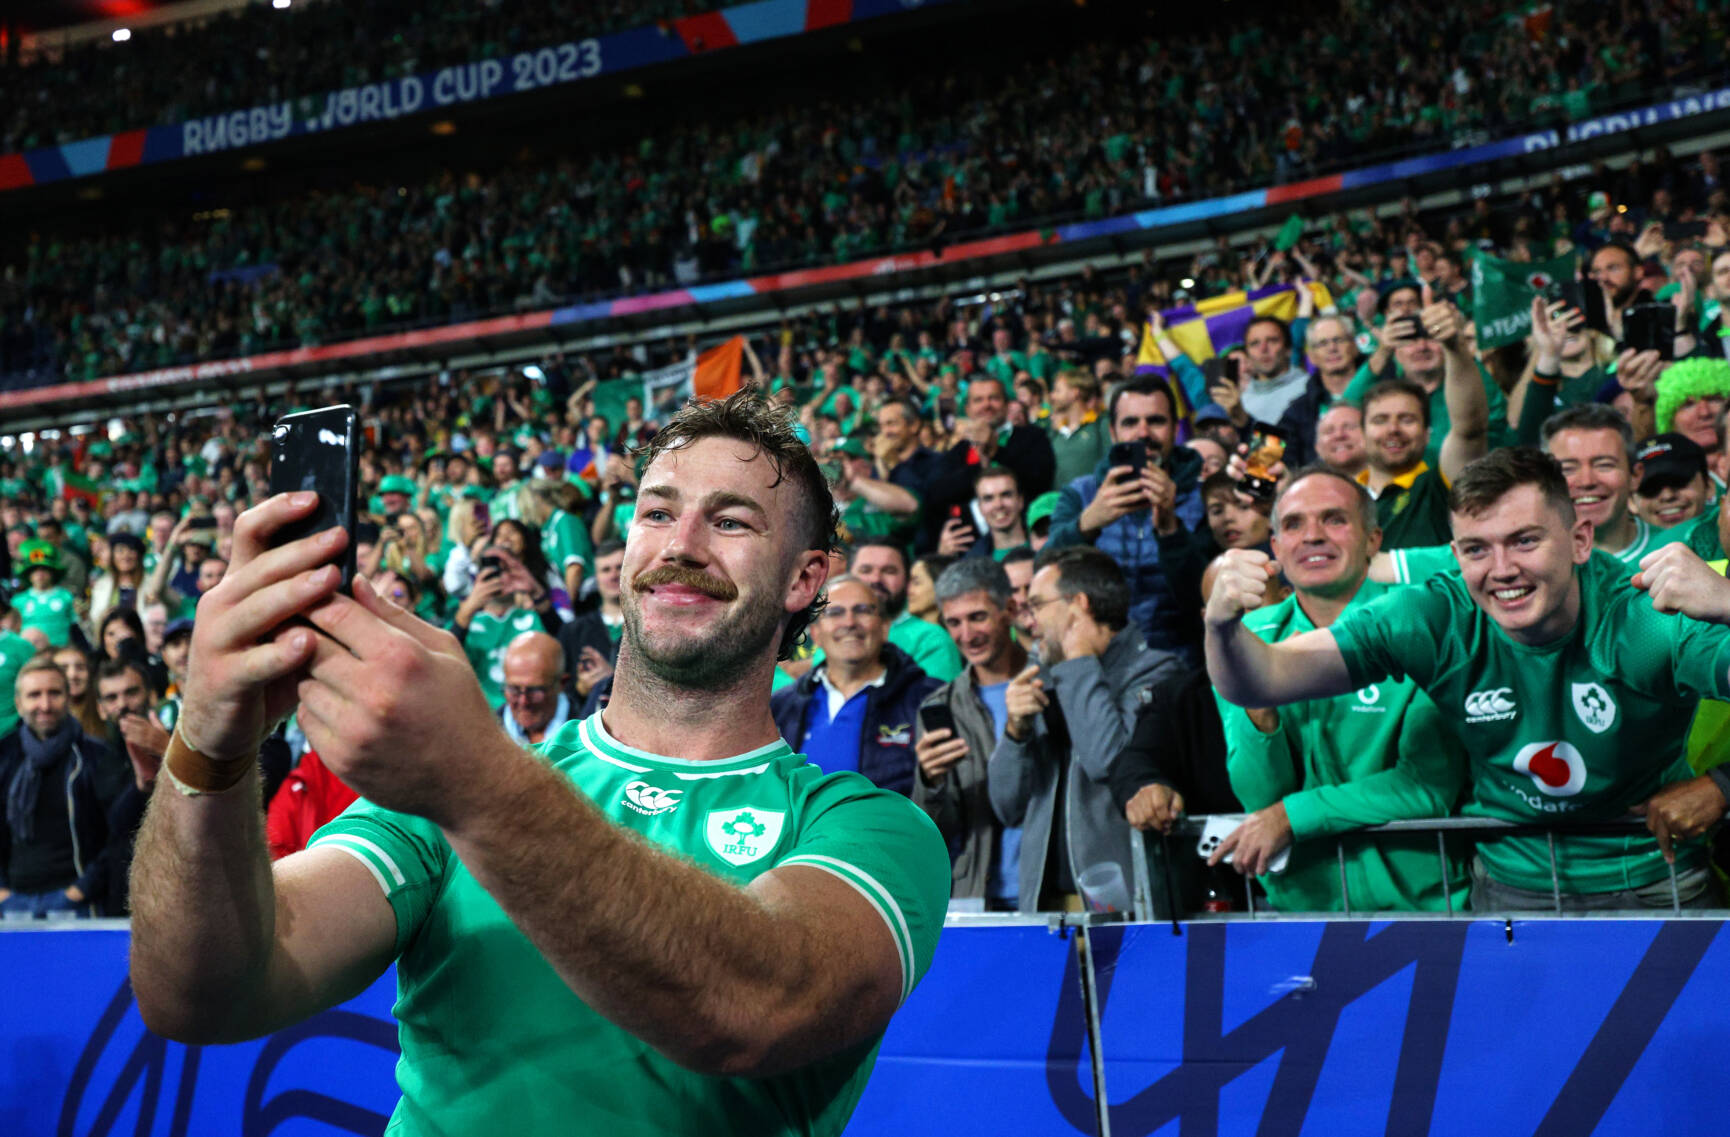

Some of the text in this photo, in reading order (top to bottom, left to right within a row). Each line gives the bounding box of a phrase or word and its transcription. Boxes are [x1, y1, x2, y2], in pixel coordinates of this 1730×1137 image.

[184, 101, 291, 156] RUGBY
[433, 59, 502, 104] CUP
[512, 38, 602, 91] 2023
[621, 800, 678, 816] canterbury
[723, 844, 758, 857] IRFU
